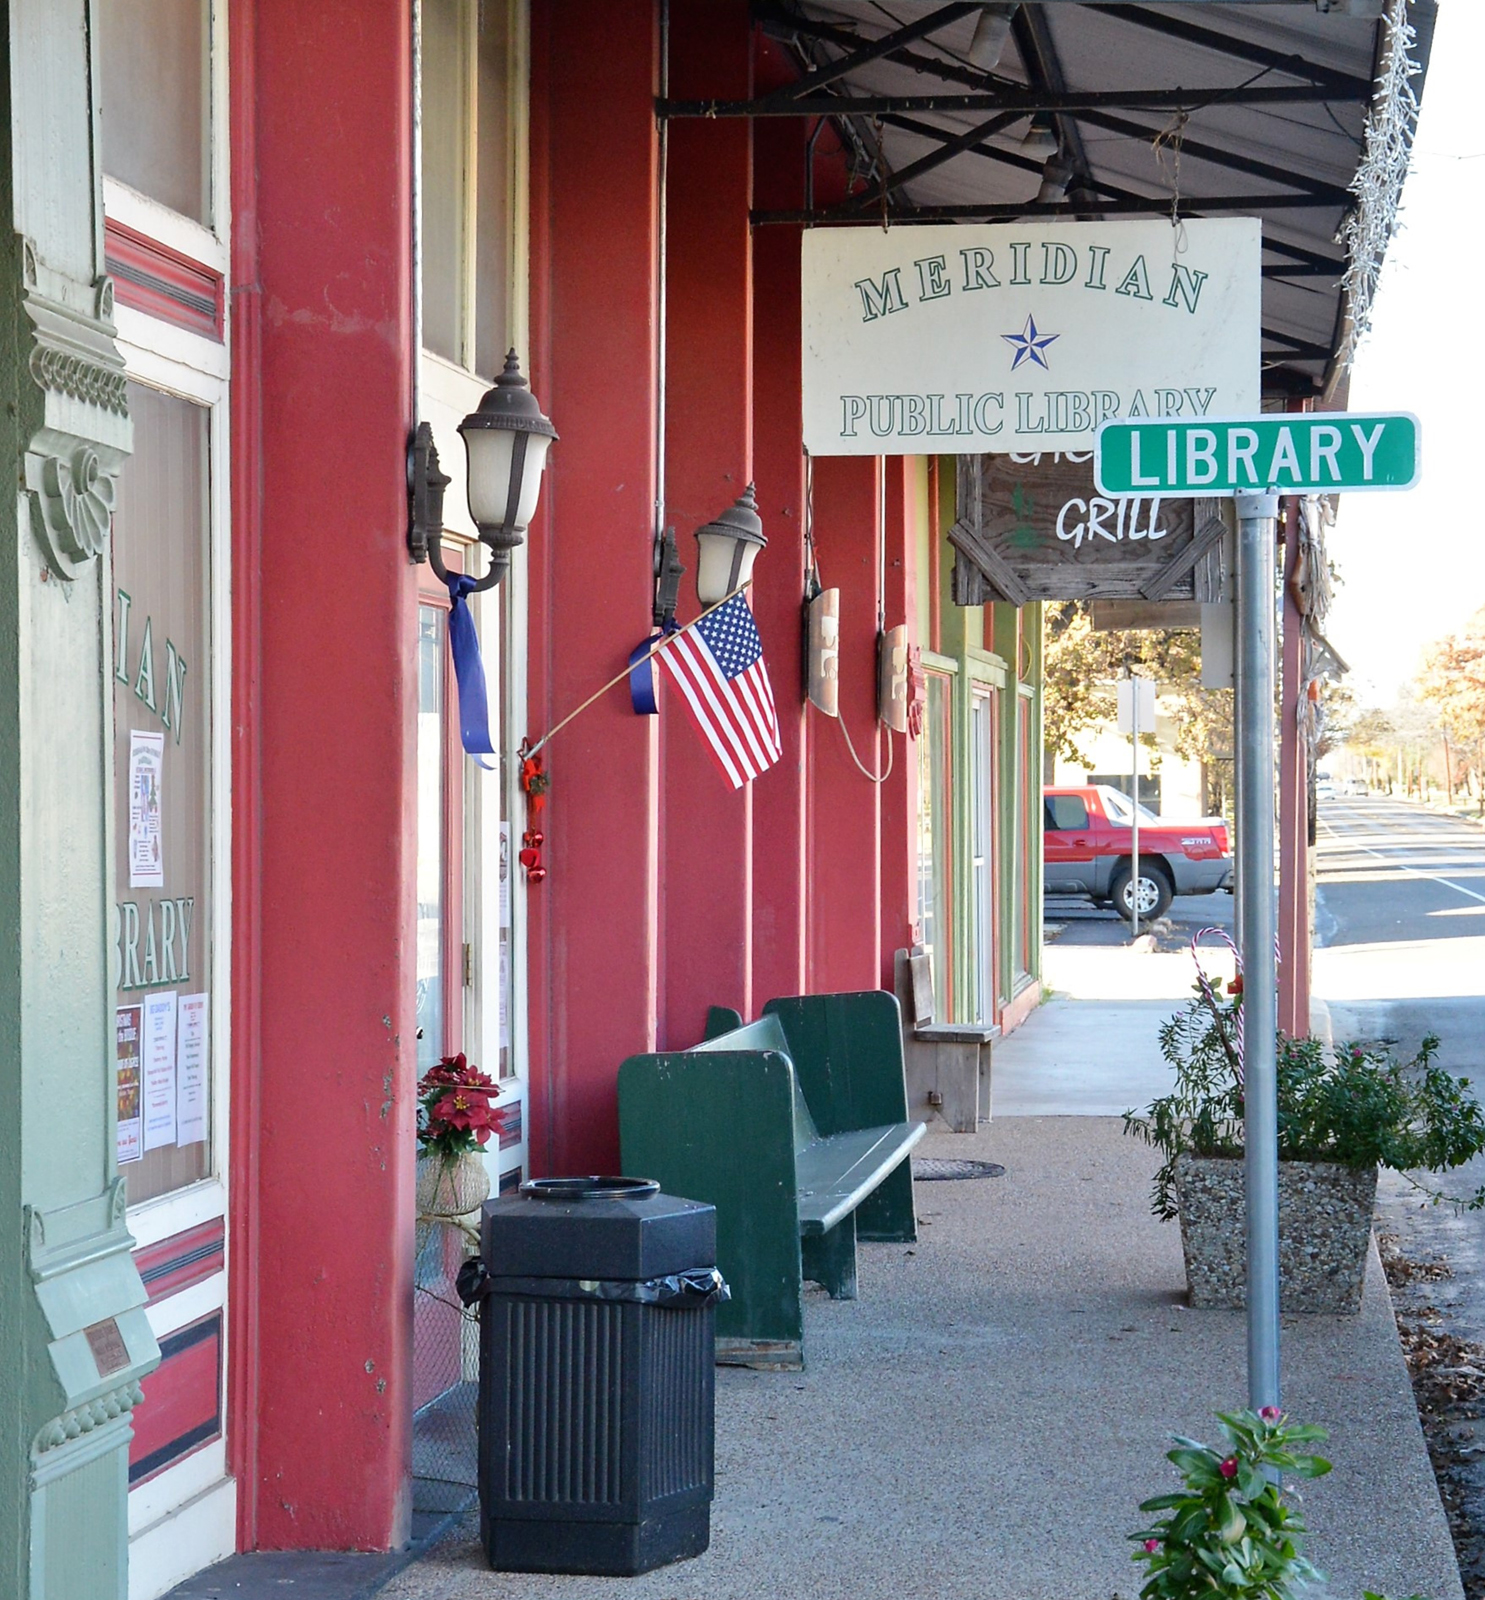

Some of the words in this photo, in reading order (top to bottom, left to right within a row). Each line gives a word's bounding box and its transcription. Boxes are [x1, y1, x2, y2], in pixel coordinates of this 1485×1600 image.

[855, 242, 1208, 322] MERIDIAN
[840, 392, 1004, 436] PUBLIC
[1015, 387, 1217, 433] LIBRARY
[1131, 423, 1386, 486] LIBRARY
[1055, 497, 1167, 548] GRILL
